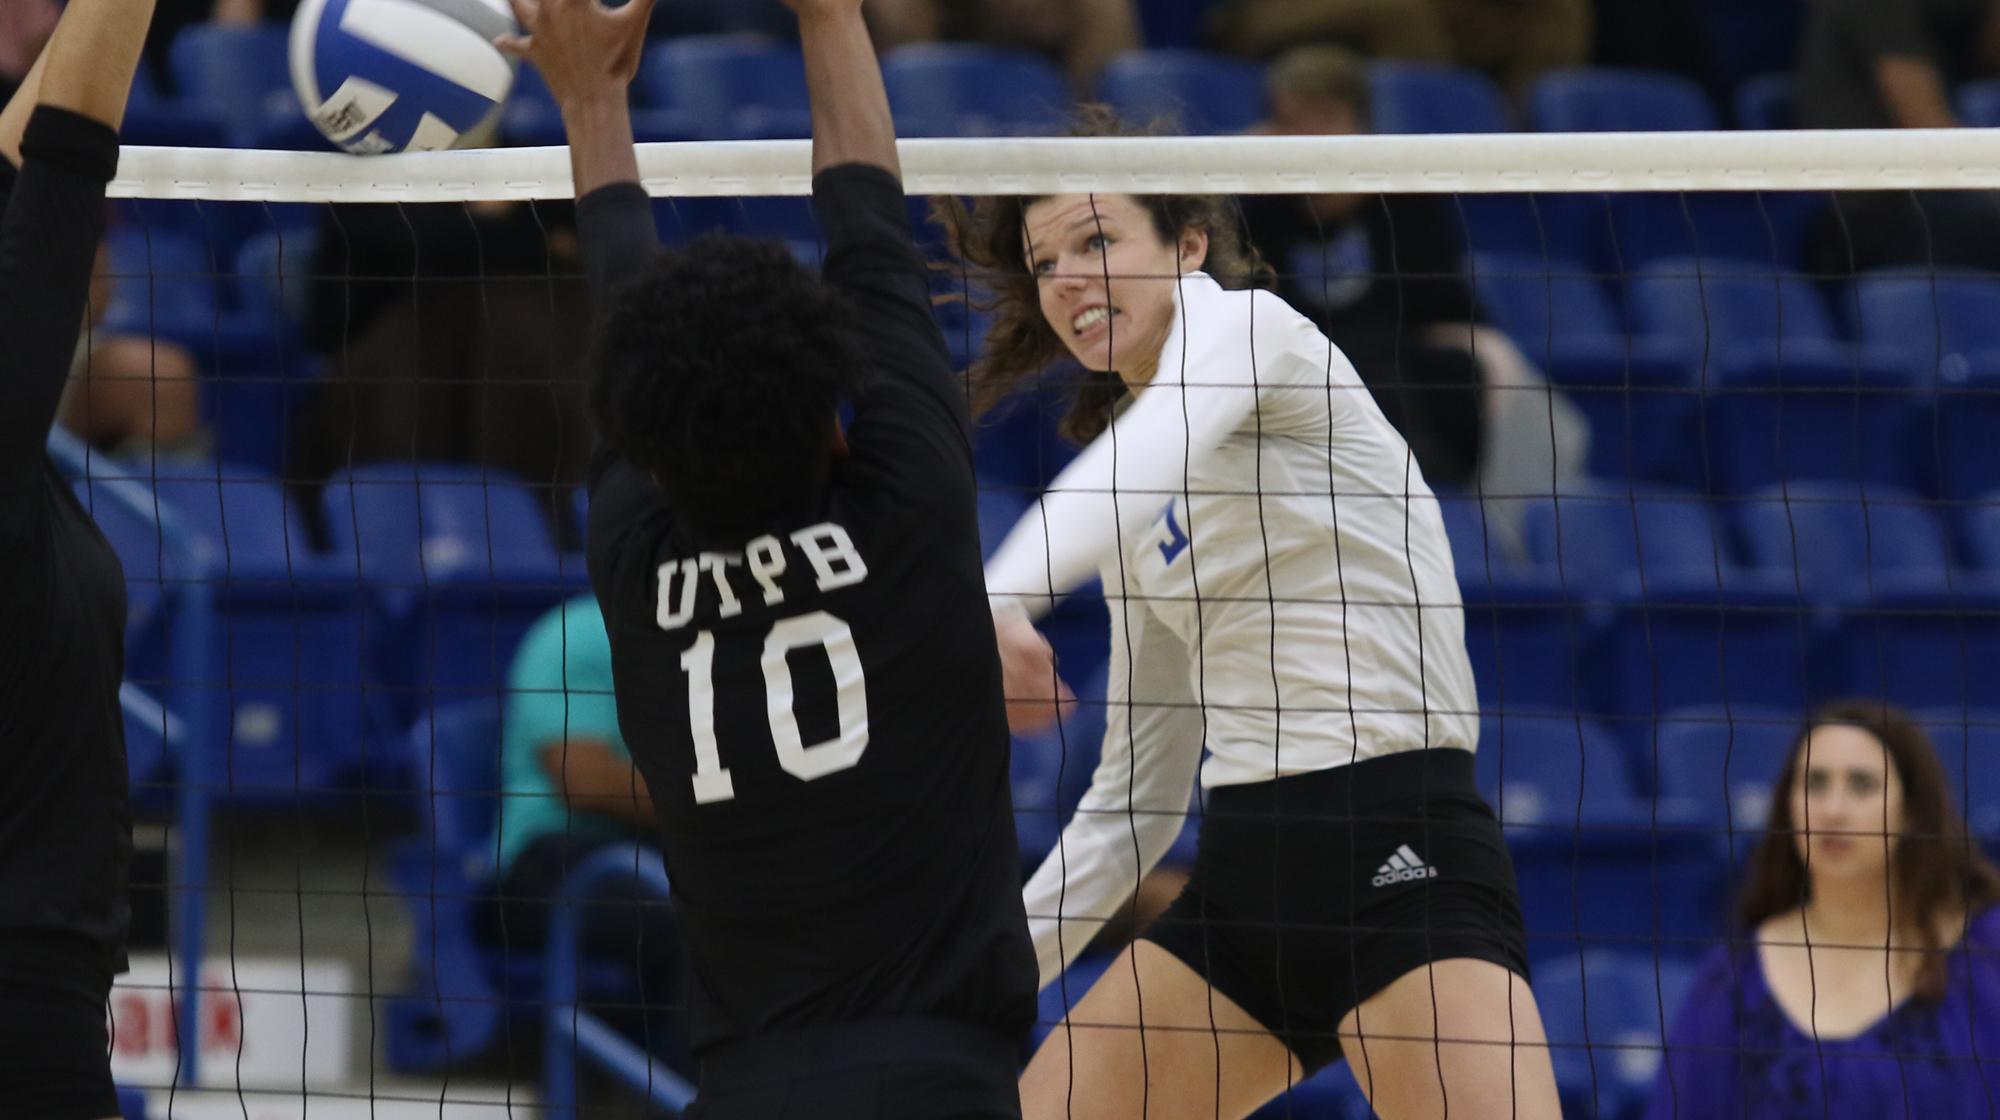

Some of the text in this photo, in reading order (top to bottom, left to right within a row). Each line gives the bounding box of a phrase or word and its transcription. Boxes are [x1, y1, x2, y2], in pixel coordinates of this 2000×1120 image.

[656, 521, 868, 631] UTPB
[680, 609, 869, 805] 10
[1371, 865, 1438, 887] adidas
